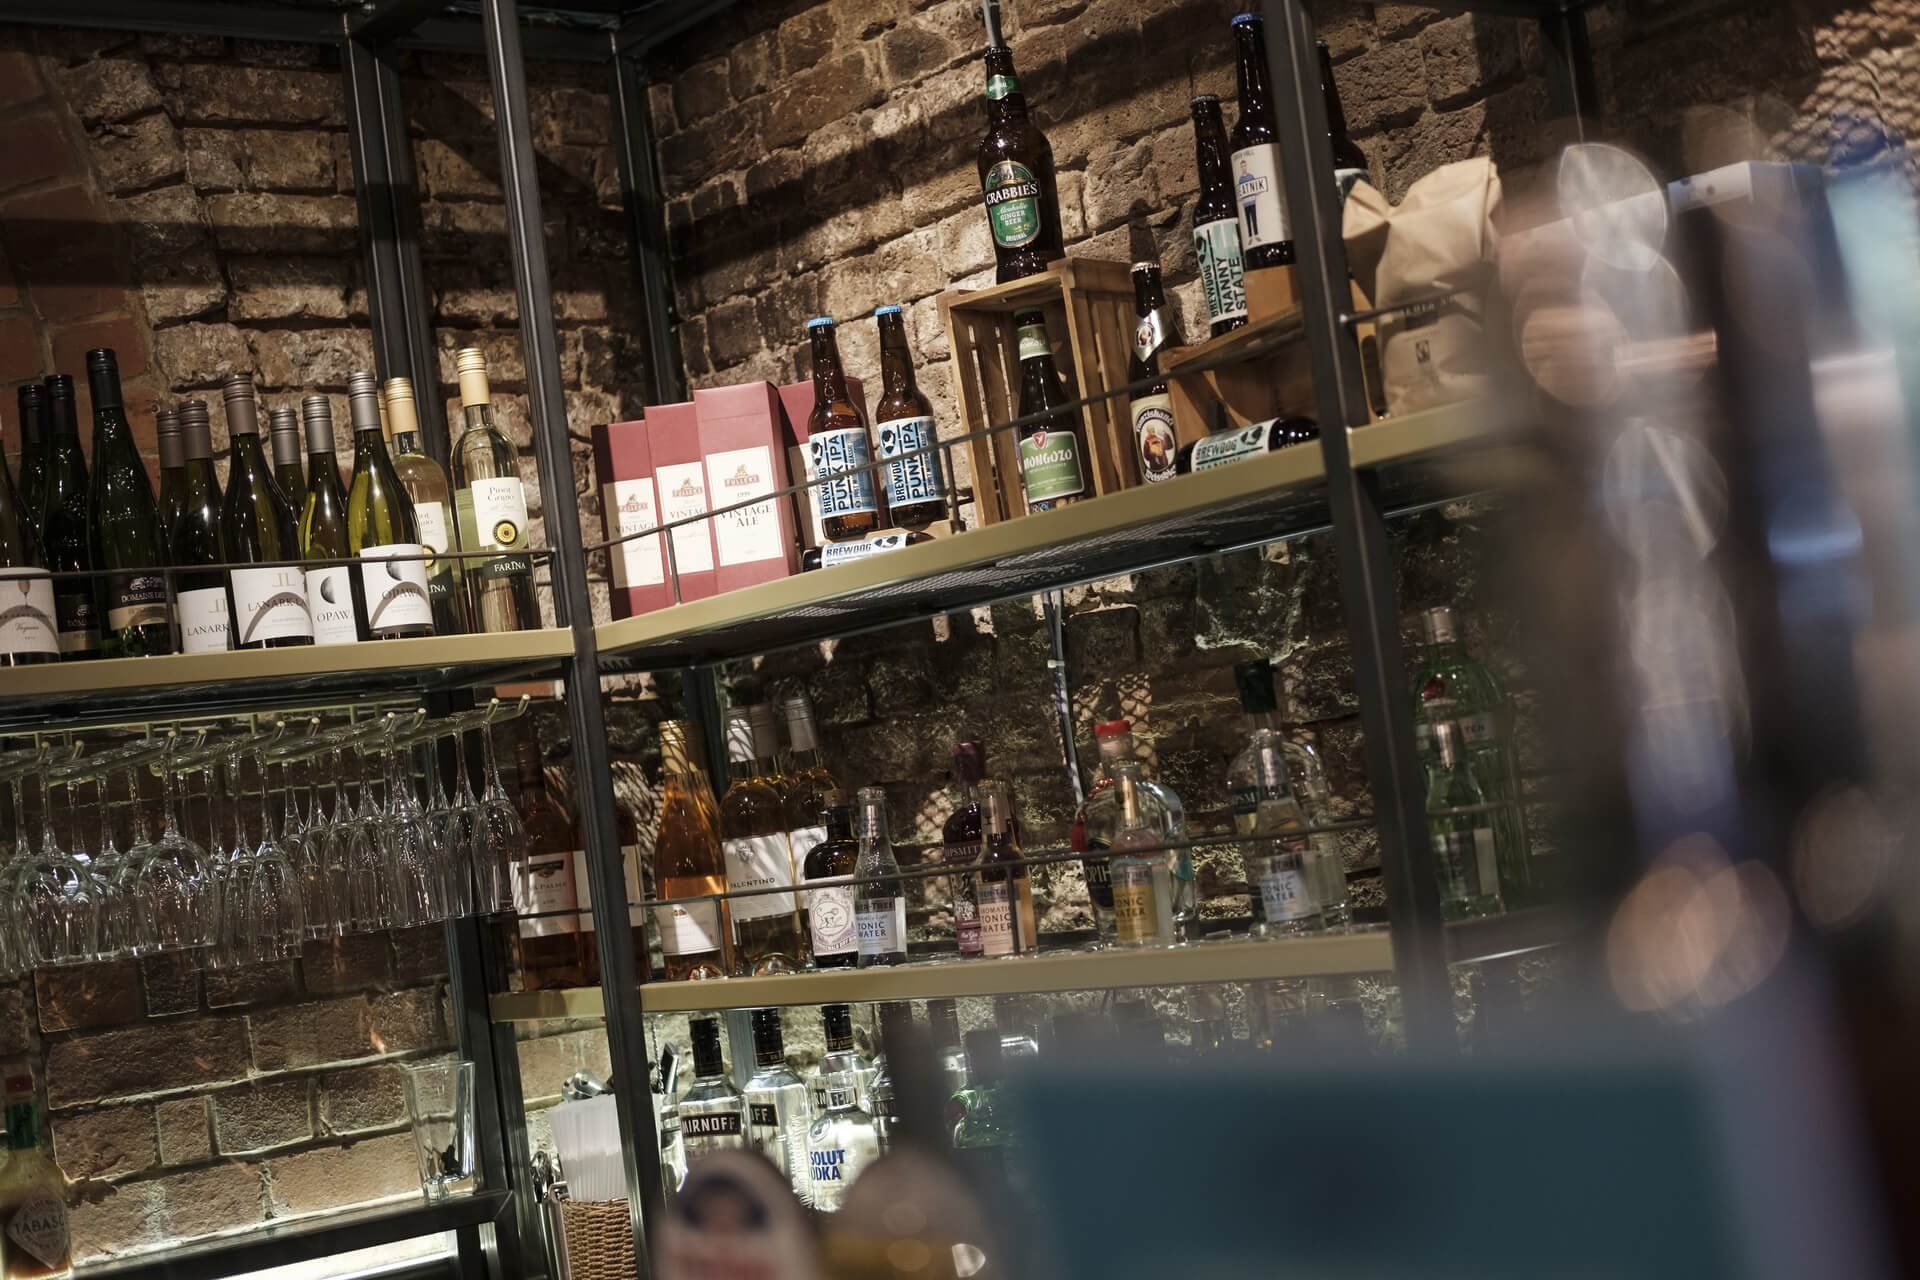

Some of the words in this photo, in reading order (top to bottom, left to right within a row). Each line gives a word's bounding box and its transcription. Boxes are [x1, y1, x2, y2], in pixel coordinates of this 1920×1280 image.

[1203, 265, 1219, 318] BREWDOG
[1216, 258, 1235, 314] NANNY
[1228, 256, 1247, 310] STATE
[902, 423, 917, 449] IPA
[828, 434, 843, 461] IPA
[1023, 448, 1073, 471] MONGOZO
[818, 467, 833, 514] BREWOG
[719, 504, 773, 520] VINTAGE
[736, 516, 759, 528] ALE
[826, 543, 872, 557] BREWDOG
[494, 560, 526, 573] FARINA
[248, 597, 295, 612] LANARK
[316, 608, 352, 623] OPAW
[186, 623, 231, 637] LANARK
